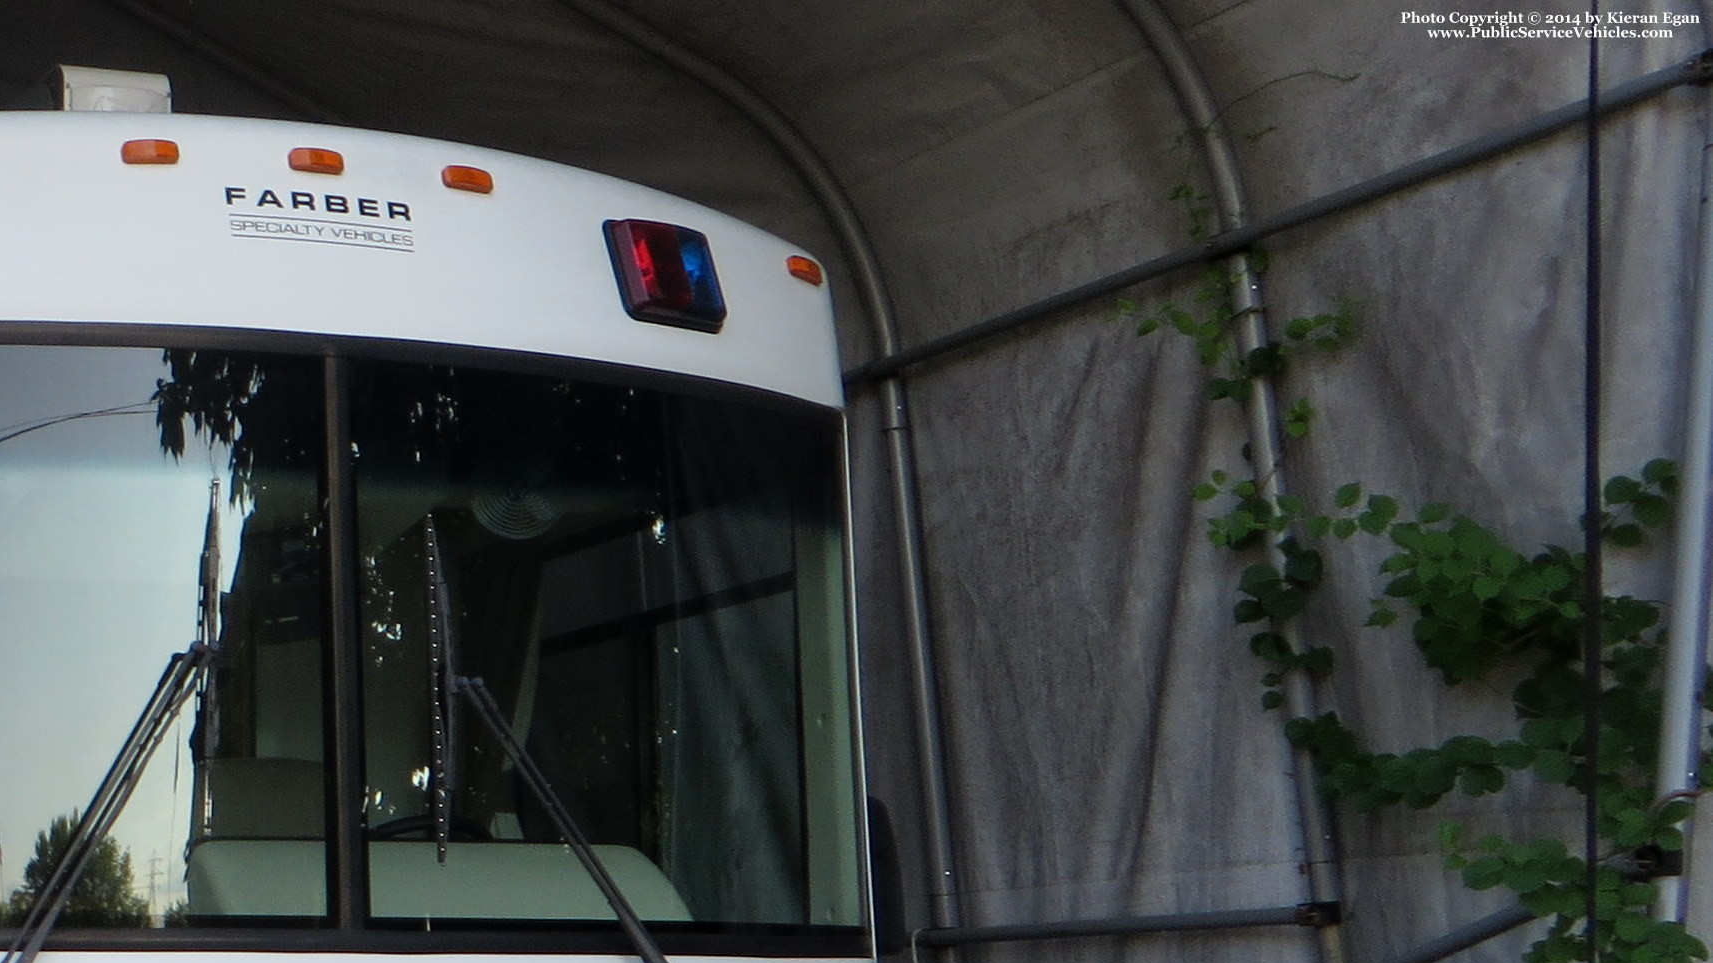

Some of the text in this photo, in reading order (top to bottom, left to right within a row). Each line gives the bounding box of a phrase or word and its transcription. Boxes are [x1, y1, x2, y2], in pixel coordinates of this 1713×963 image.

[225, 186, 412, 221] FARBER
[230, 219, 414, 247] SPECIALTY VEHICLES
